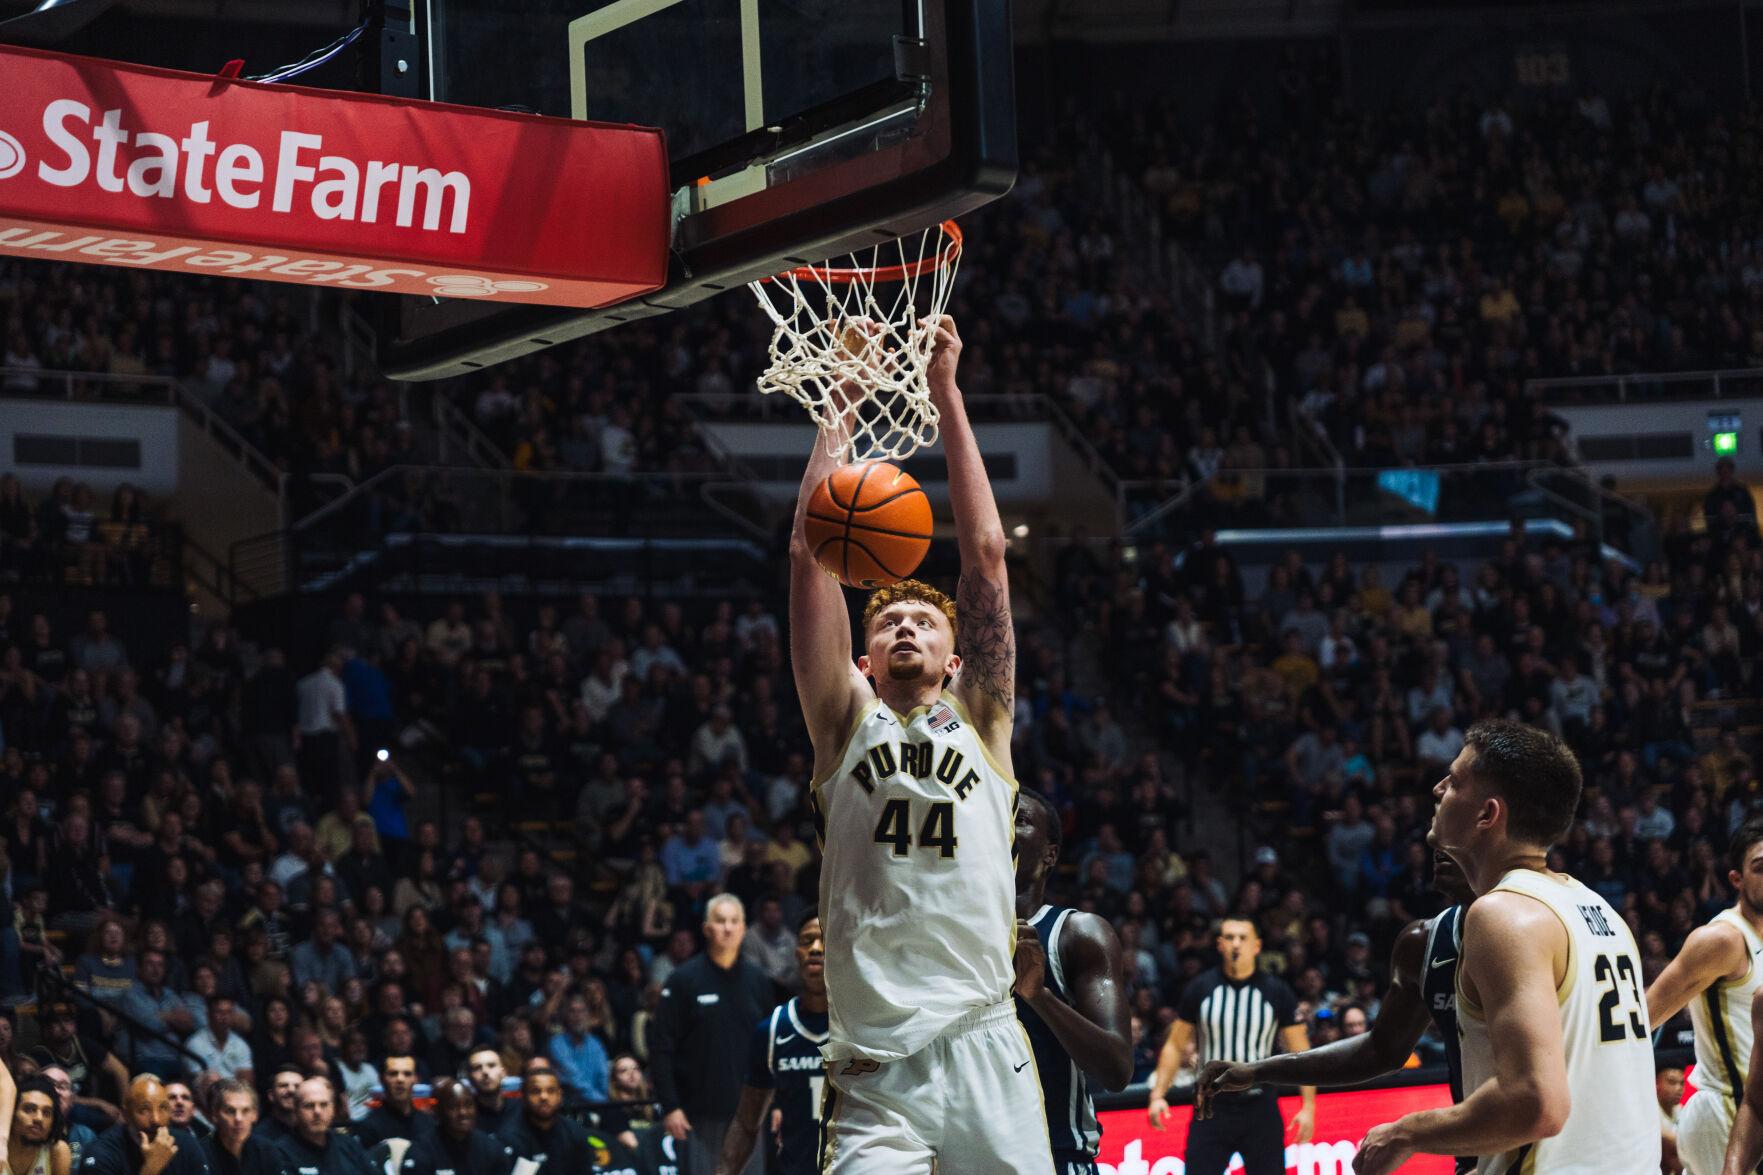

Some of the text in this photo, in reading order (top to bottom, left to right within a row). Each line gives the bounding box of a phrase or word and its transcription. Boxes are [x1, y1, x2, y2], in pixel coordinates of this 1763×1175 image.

[38, 99, 471, 234] State Farm
[850, 740, 981, 802] PURDUE
[874, 798, 958, 860] 44
[1593, 953, 1648, 1043] 23
